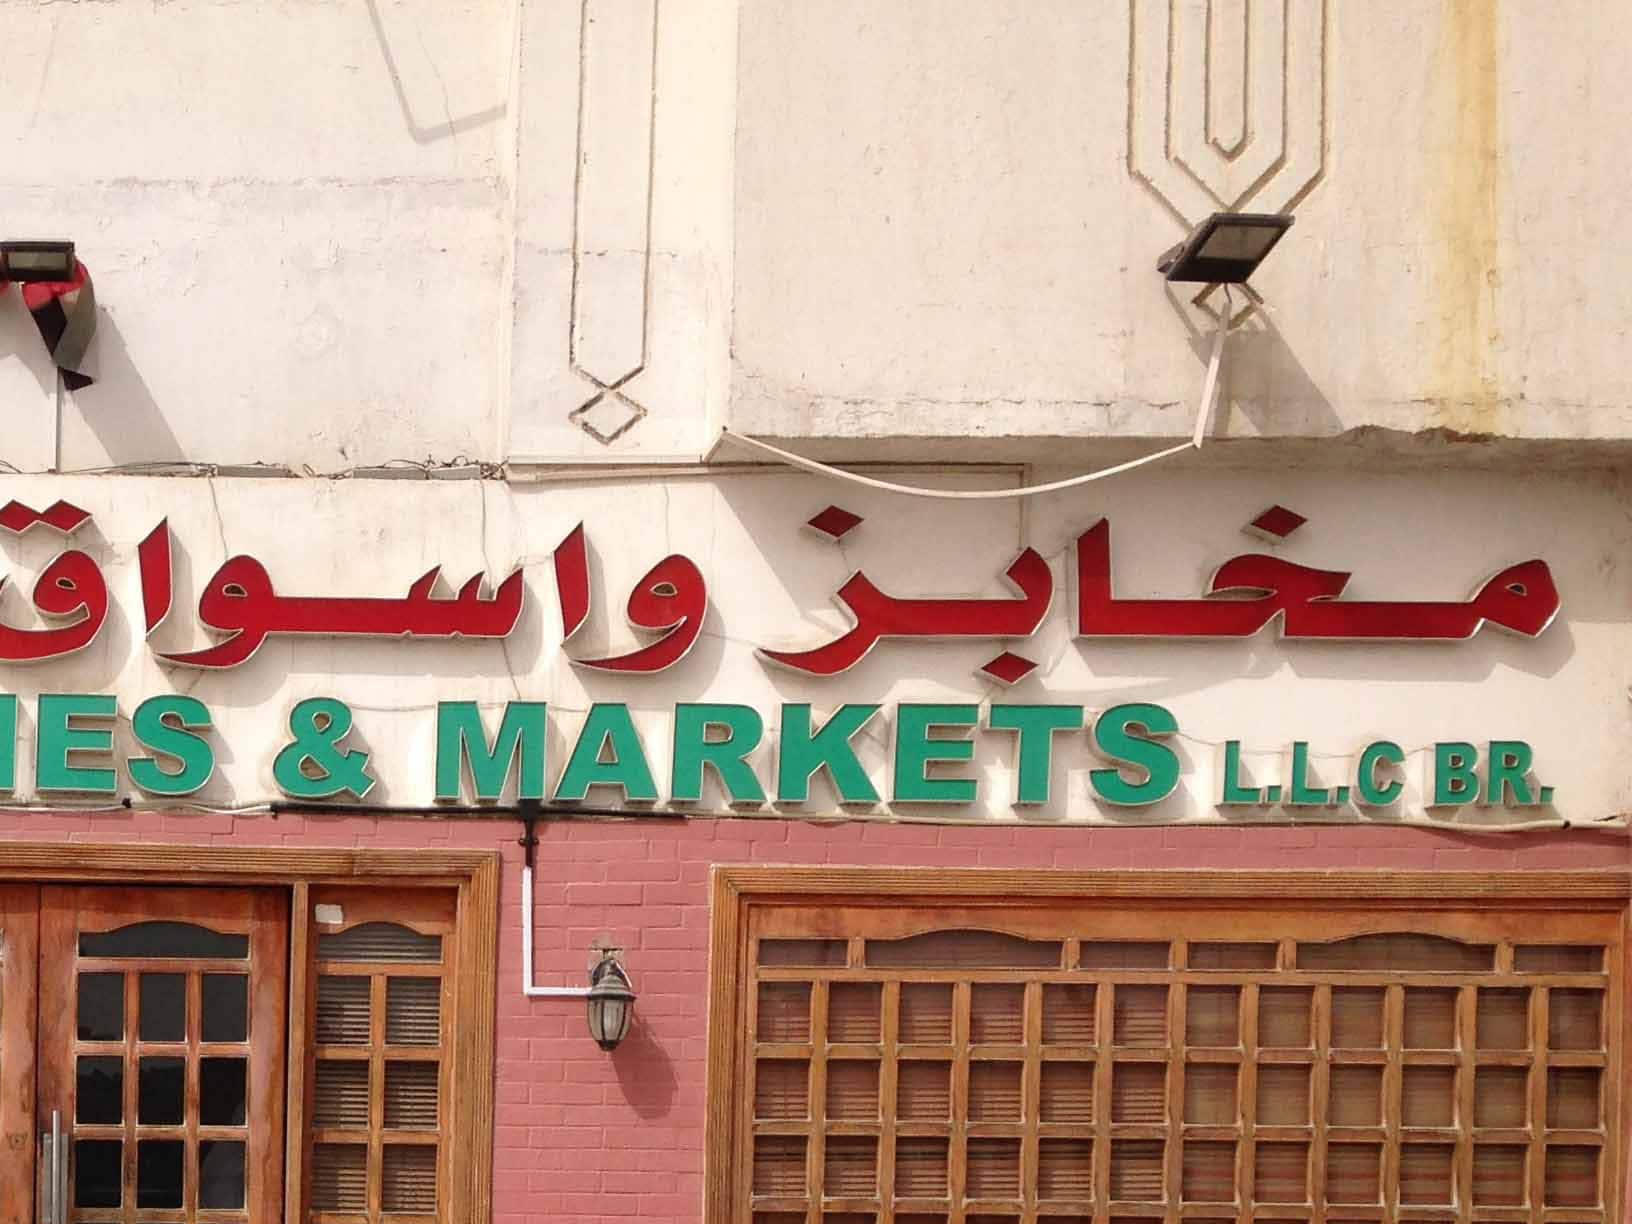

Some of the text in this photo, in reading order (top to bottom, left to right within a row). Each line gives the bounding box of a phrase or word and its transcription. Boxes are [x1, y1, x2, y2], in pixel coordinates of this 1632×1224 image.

[758, 503, 1561, 685] مخابز
[272, 697, 375, 798] &
[434, 701, 1181, 806] MARKETS
[1223, 740, 1404, 806] L.L.C
[1434, 740, 1555, 806] BR.
